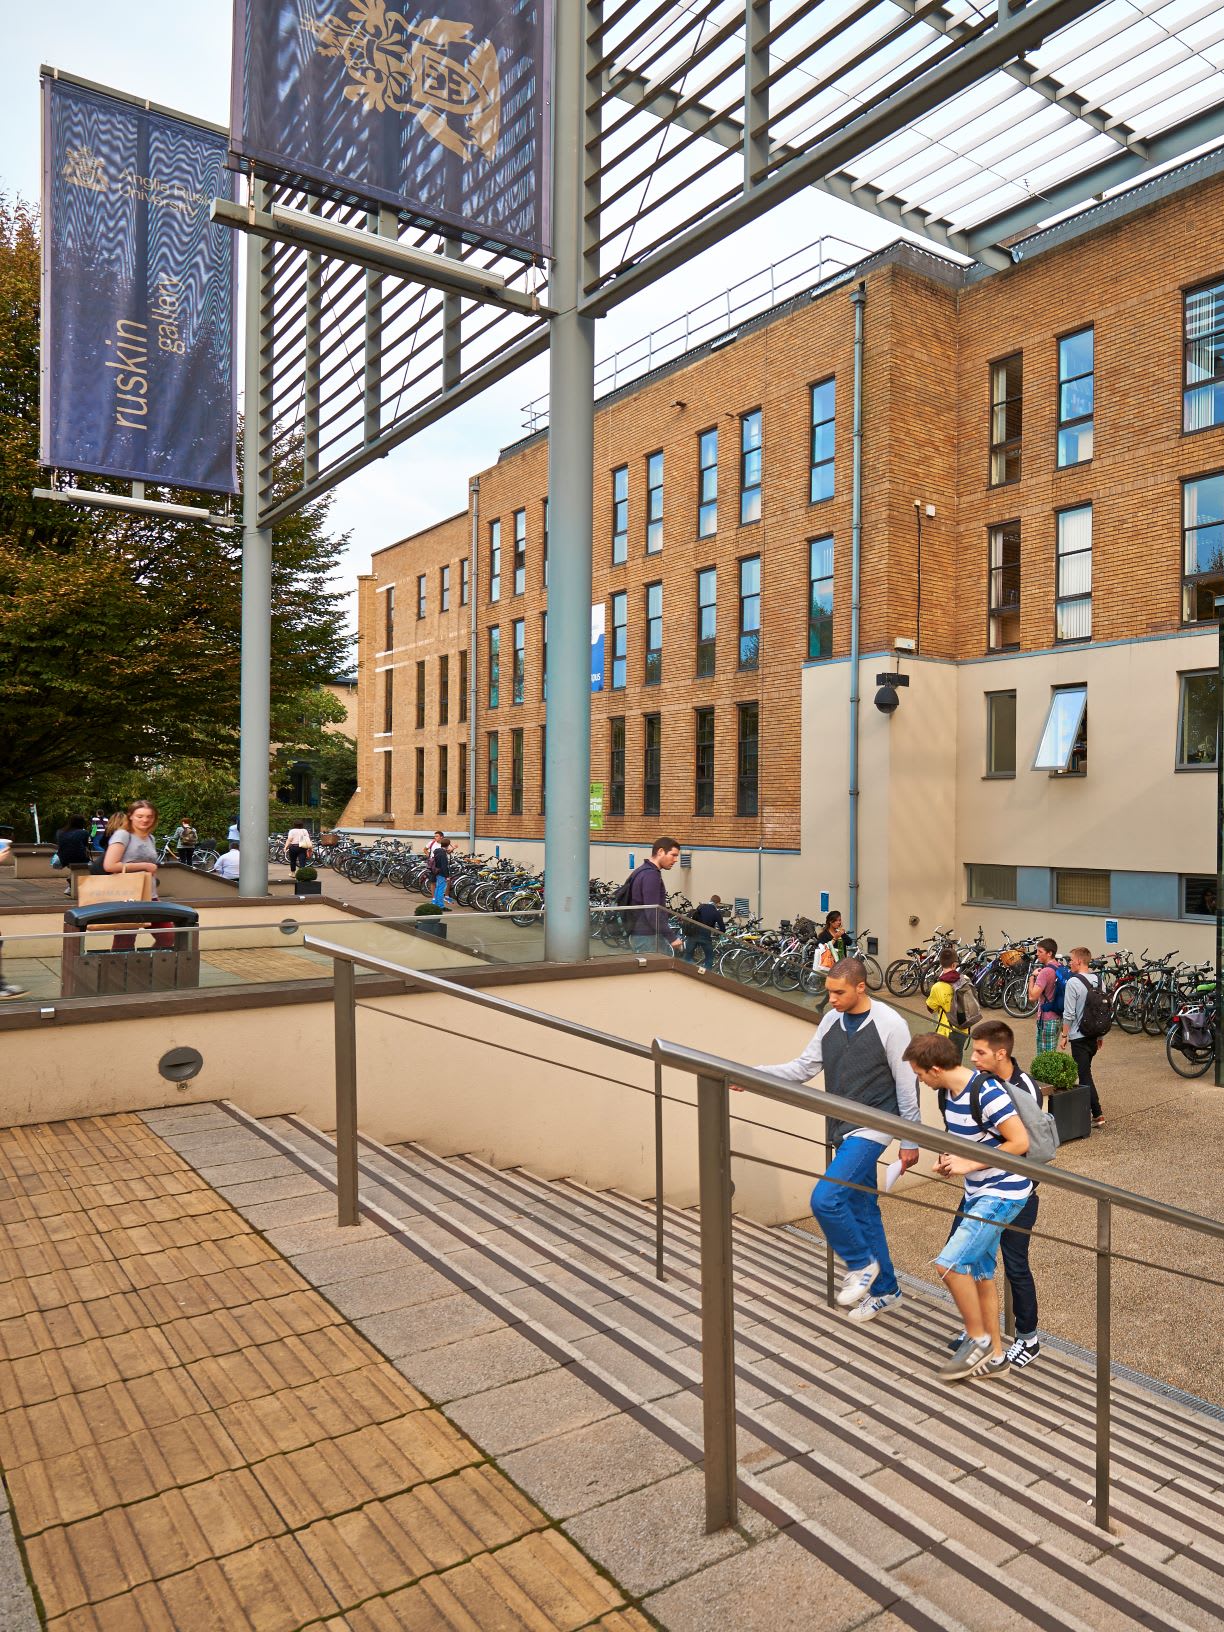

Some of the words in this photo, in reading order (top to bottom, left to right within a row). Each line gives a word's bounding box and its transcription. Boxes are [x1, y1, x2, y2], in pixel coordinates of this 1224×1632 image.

[118, 168, 171, 192] Anglia
[118, 182, 200, 217] University
[152, 272, 186, 354] gallery
[105, 319, 148, 430] ruskin
